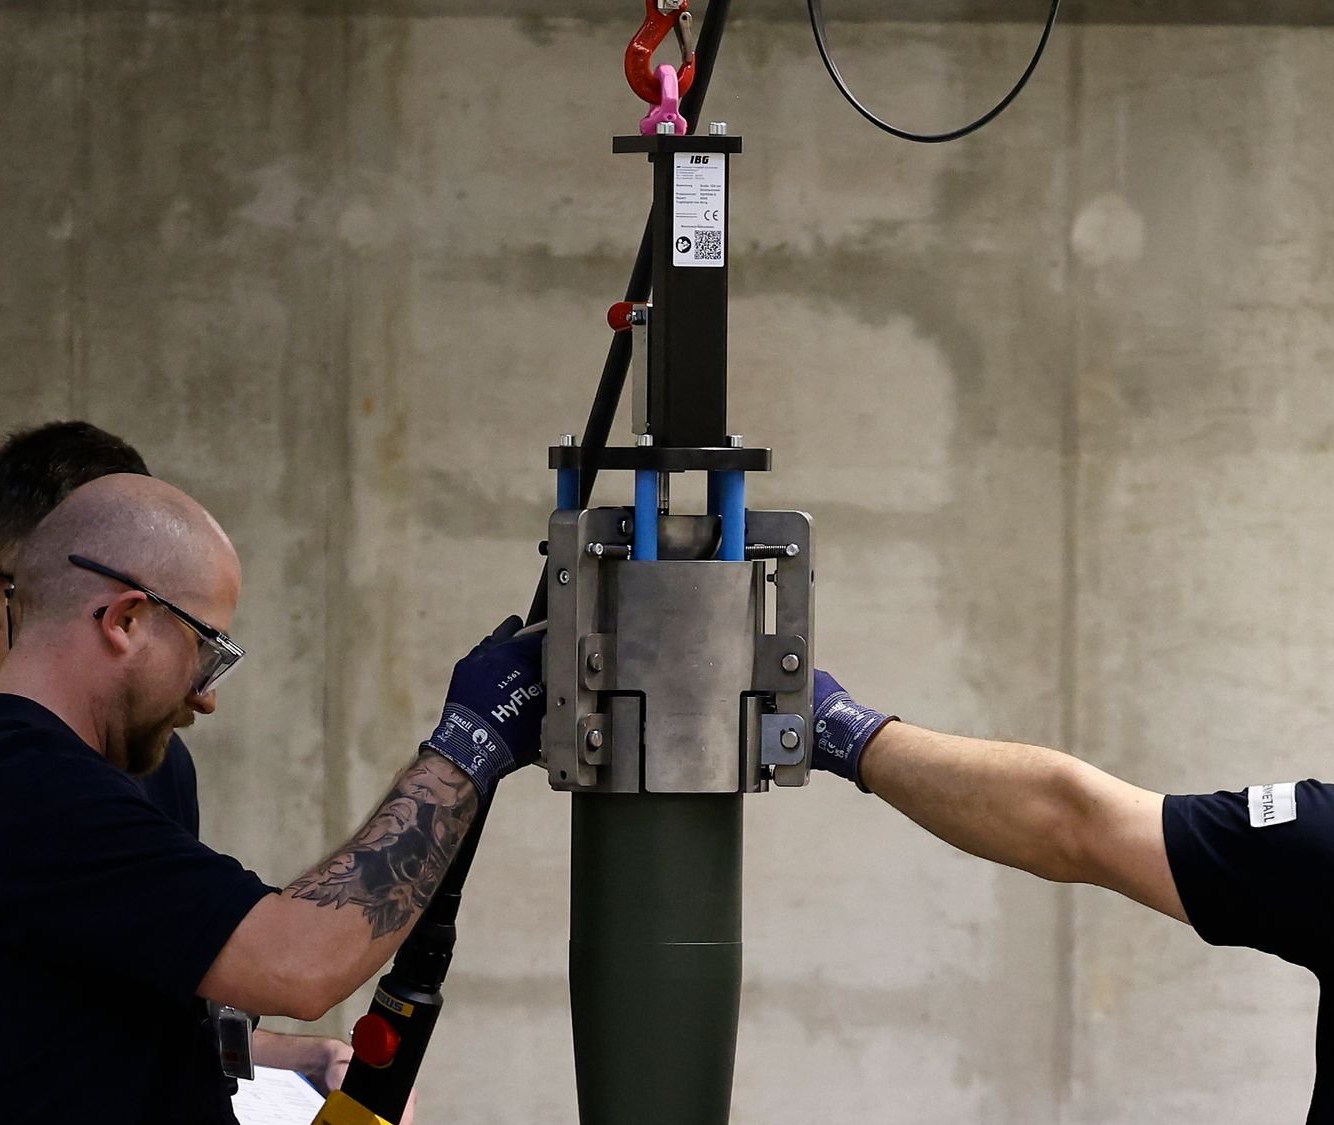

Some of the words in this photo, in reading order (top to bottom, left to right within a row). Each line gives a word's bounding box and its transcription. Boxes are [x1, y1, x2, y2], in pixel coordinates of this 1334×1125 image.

[690, 155, 710, 164] IBG
[497, 670, 521, 689] 11-561
[449, 712, 473, 731] Ansell
[485, 740, 497, 752] 10
